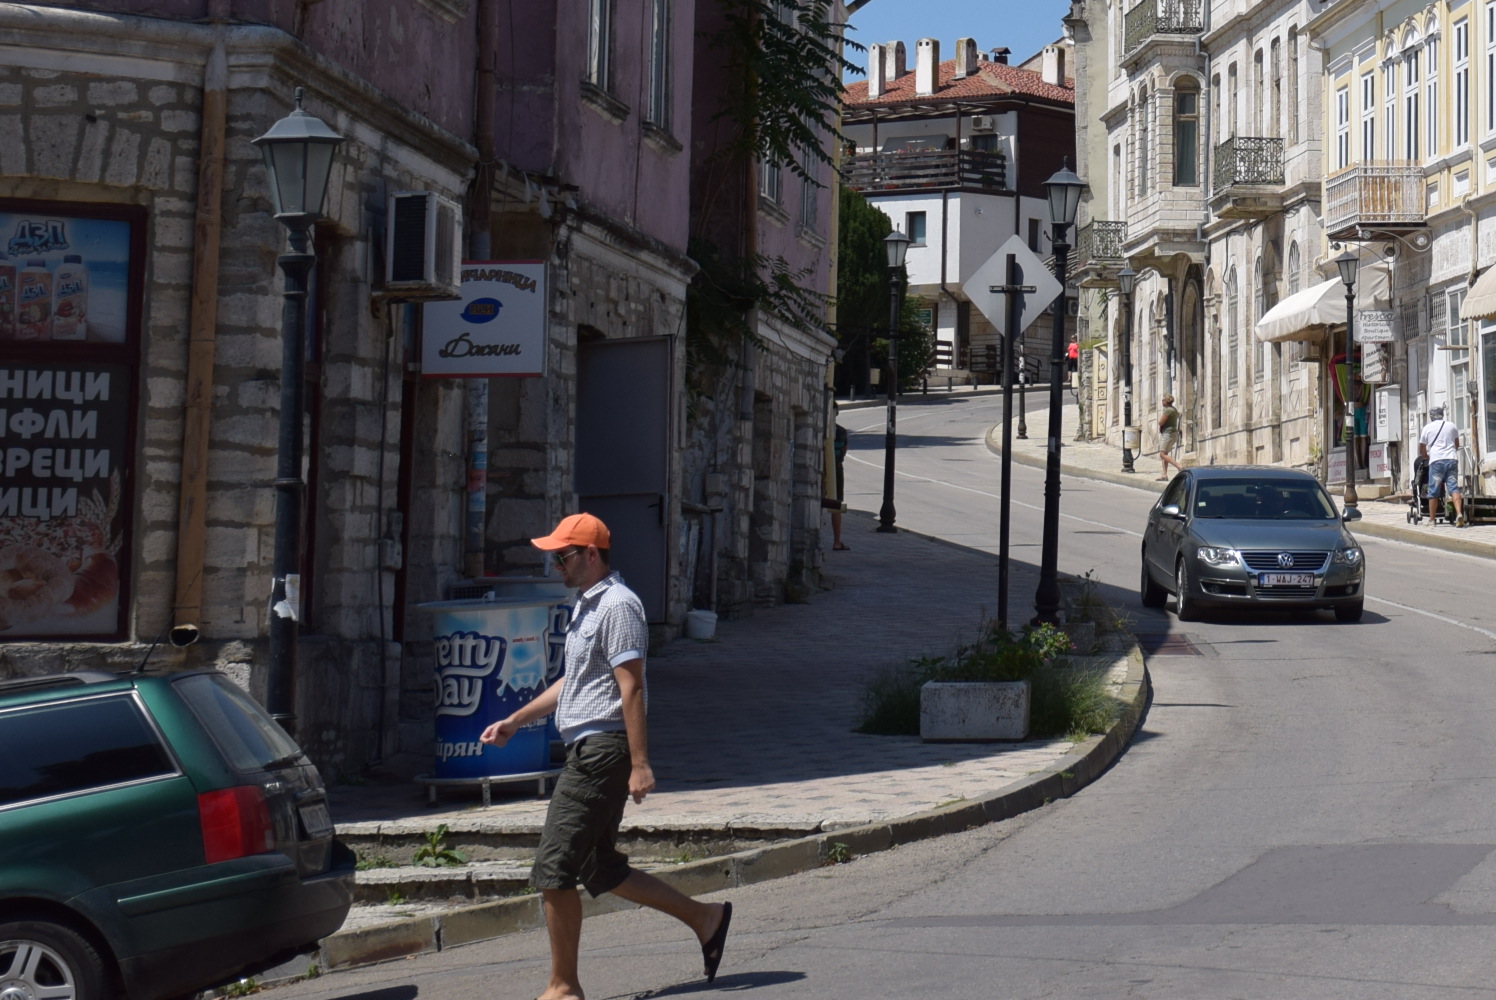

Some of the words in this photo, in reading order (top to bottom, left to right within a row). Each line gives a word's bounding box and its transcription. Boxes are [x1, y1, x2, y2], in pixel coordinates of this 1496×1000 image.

[8, 220, 68, 250] ДЗП
[0, 448, 110, 482] РЕЦИ
[1266, 575, 1313, 584] 1-WAJ-247
